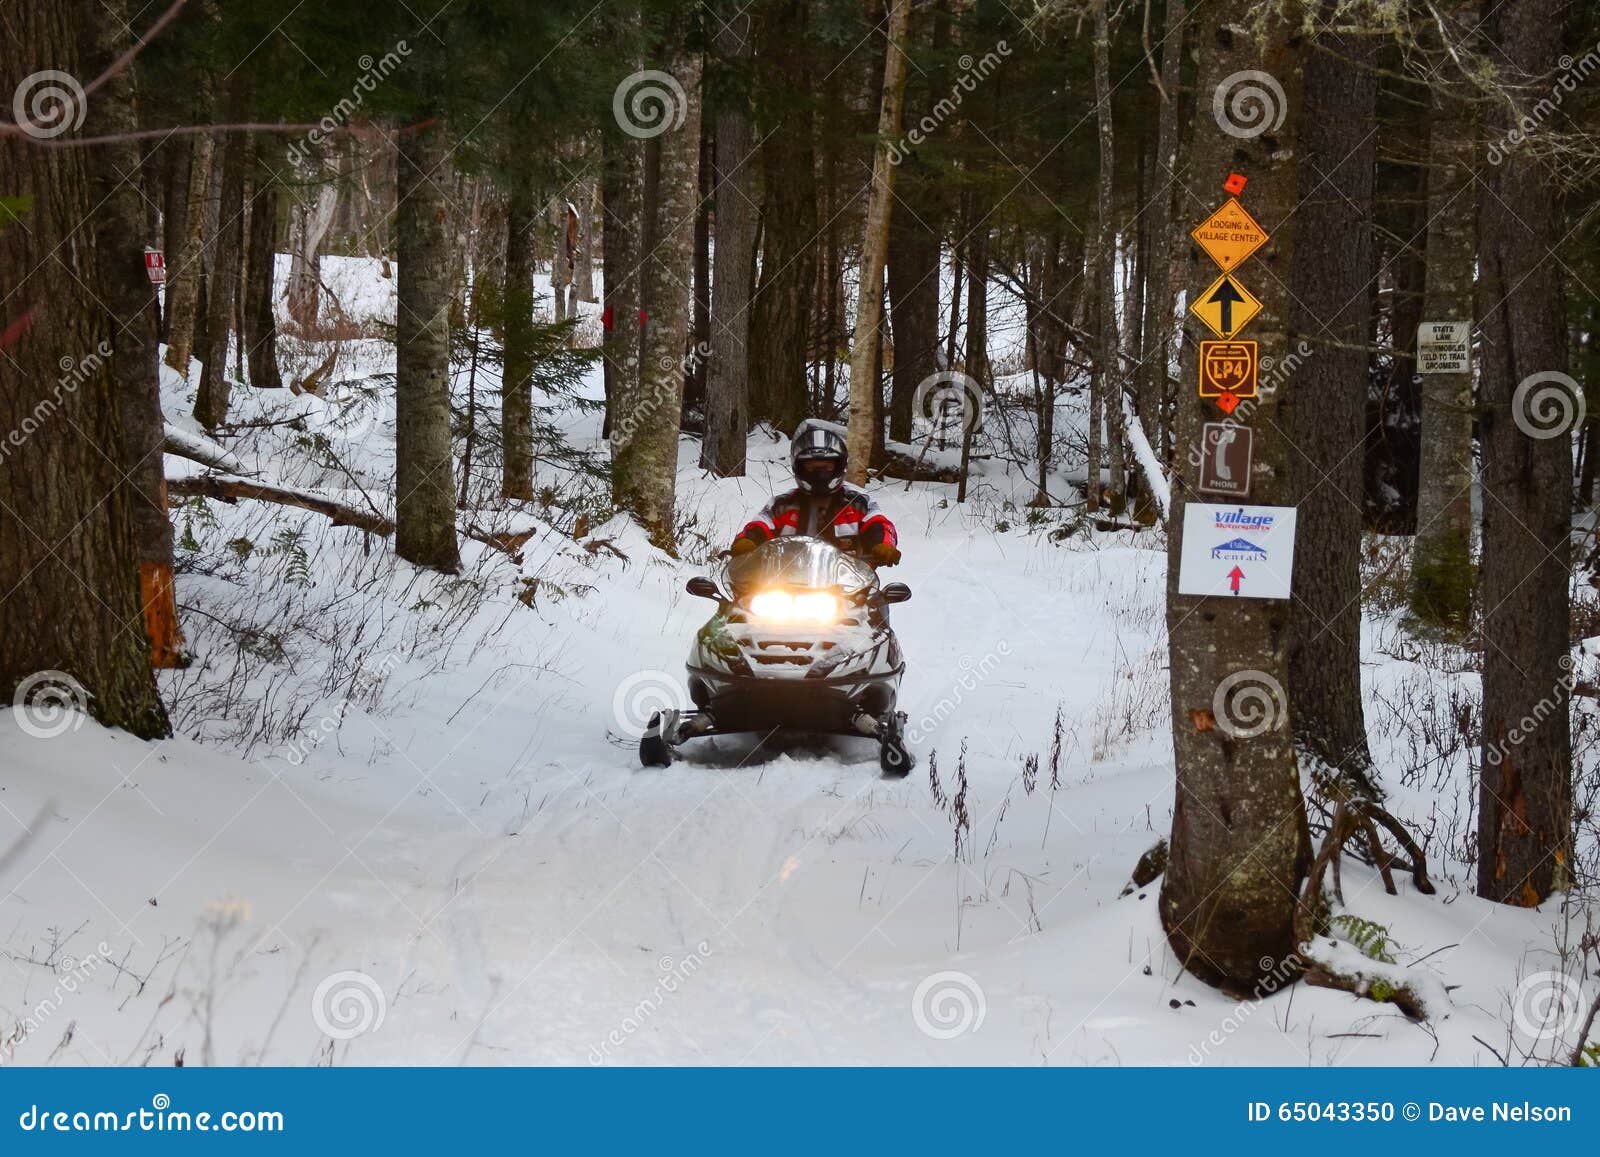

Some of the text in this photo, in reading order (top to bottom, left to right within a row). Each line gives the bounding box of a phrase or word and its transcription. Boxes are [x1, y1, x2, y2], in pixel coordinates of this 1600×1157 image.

[1199, 231, 1259, 243] VILLAGE CENTER
[1433, 325, 1455, 333] STATE
[1439, 353, 1447, 361] TO
[1449, 353, 1466, 361] TRAIL
[1213, 360, 1243, 379] LP4
[1210, 479, 1239, 489] PHONE
[1215, 511, 1274, 526] Village
